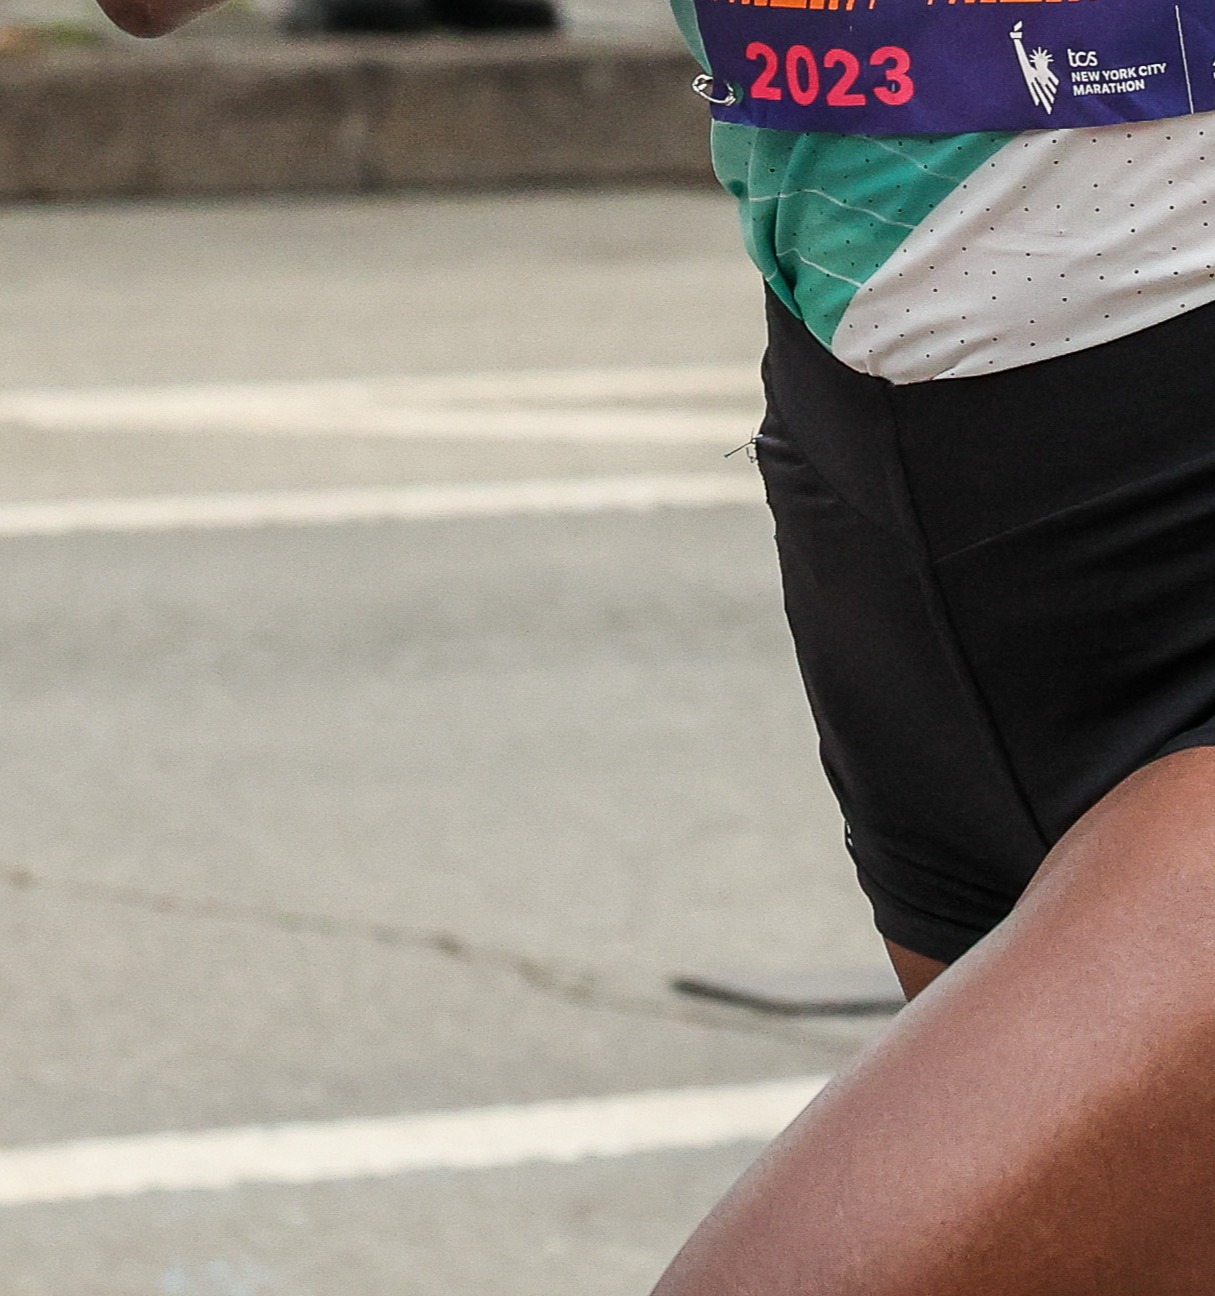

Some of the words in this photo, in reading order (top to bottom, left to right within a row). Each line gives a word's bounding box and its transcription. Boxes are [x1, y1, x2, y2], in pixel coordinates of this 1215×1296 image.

[1067, 48, 1098, 67] tcs
[745, 41, 914, 106] 2023
[1071, 71, 1100, 83] NEW
[1102, 67, 1137, 81] YORK
[1138, 62, 1167, 77] CITY
[1072, 78, 1146, 96] MARATHON
